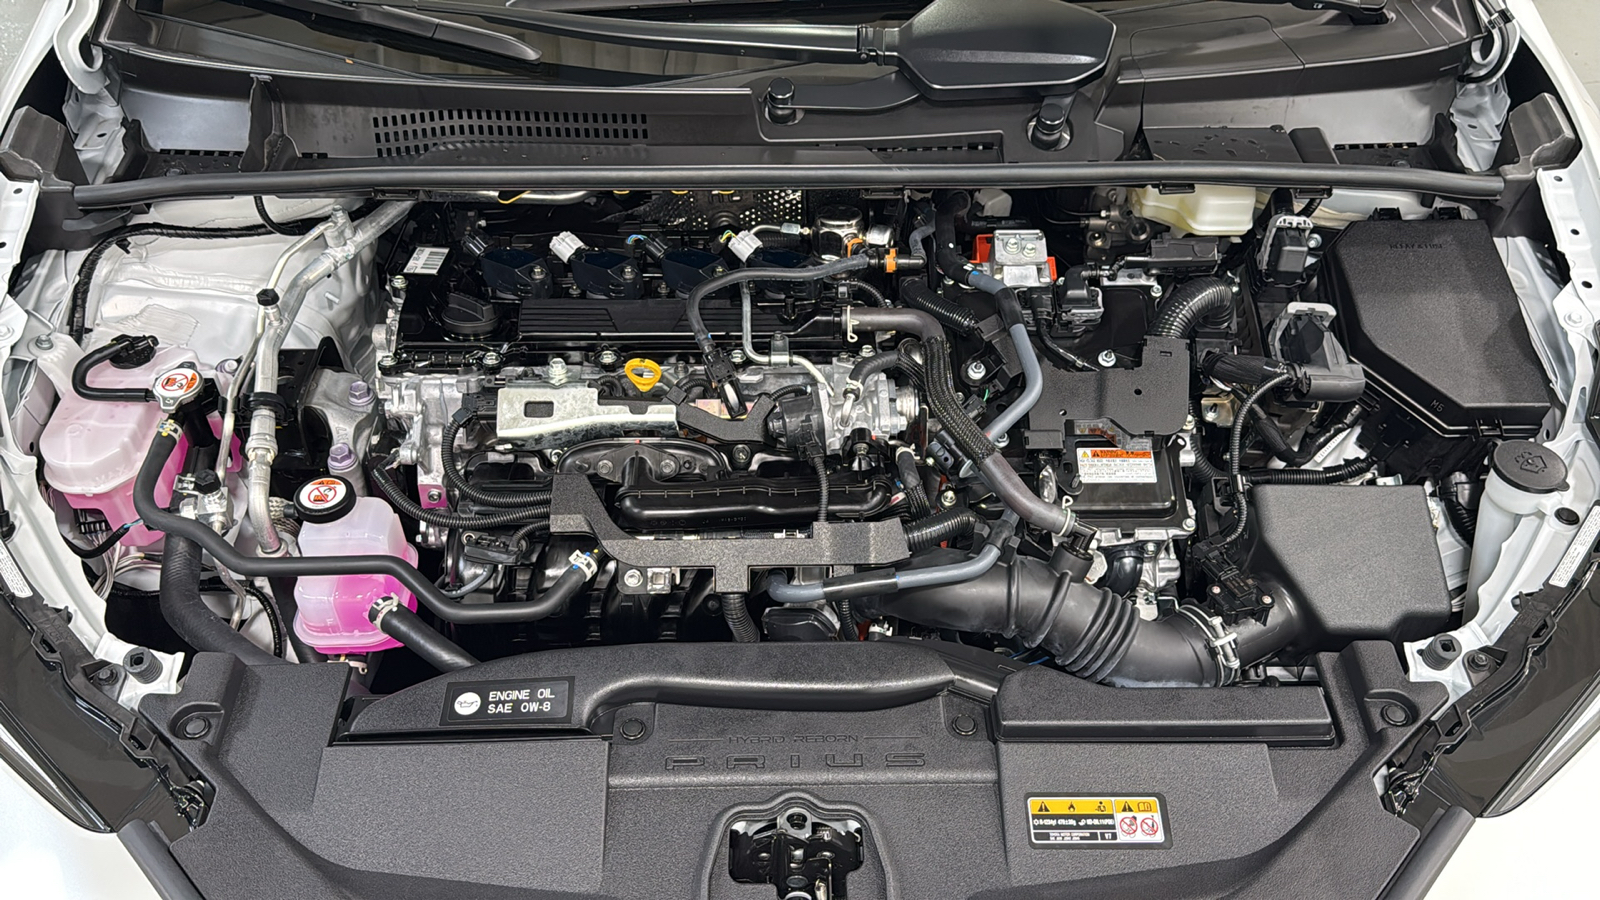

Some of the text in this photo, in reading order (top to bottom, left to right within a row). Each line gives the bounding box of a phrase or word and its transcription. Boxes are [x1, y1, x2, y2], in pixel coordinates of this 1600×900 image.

[488, 688, 555, 702] ENGINE OIL
[487, 701, 551, 714] SAE 0W-8
[728, 734, 859, 744] HYBRID REBORN
[665, 752, 926, 770] PRIUS
